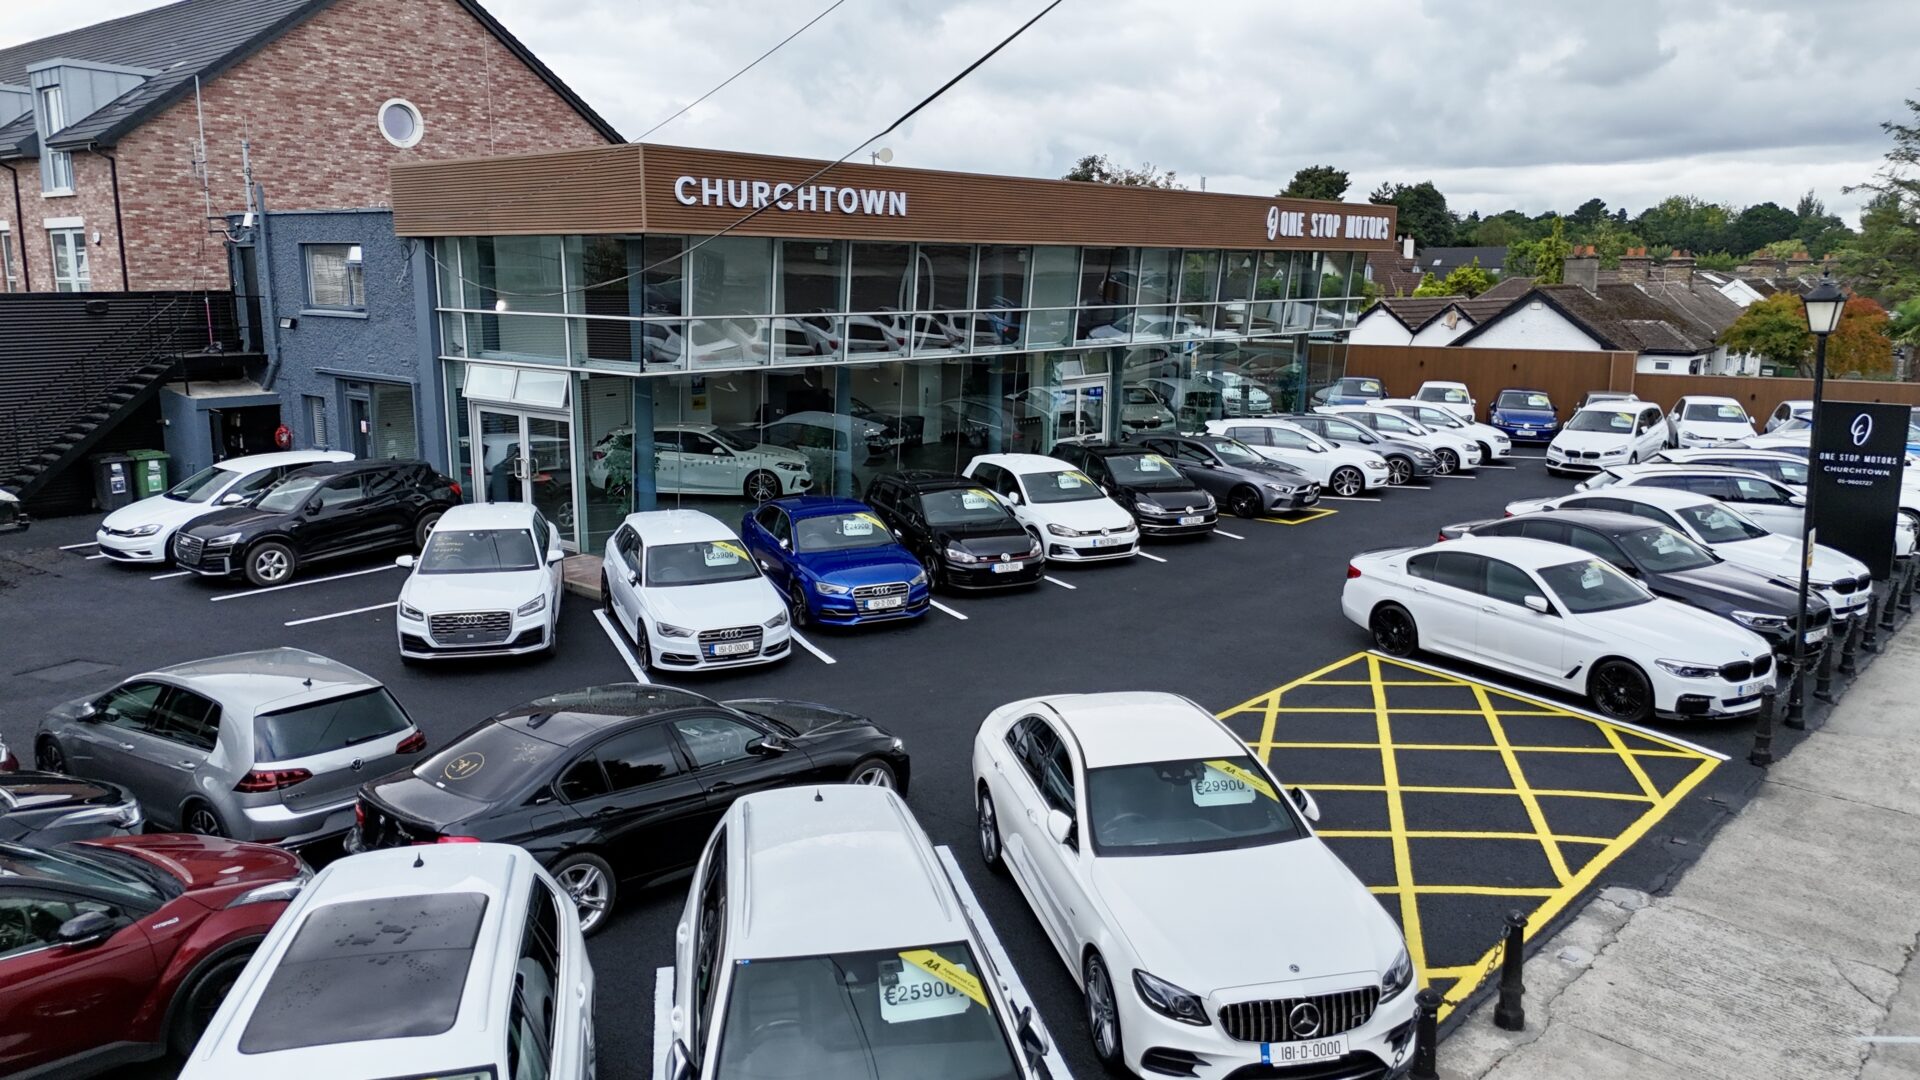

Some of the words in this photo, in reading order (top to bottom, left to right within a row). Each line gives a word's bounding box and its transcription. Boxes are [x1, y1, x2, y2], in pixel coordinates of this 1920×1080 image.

[674, 175, 907, 217] CHURCHTOWN
[1280, 211, 1305, 237] ONE
[1310, 213, 1341, 238] STOP
[1345, 215, 1390, 240] MOTORS
[1819, 452, 1836, 461] ONE
[1839, 453, 1860, 462] STOP
[1863, 455, 1897, 465] MOTORS
[1823, 465, 1890, 476] CHURCHTOWN
[718, 642, 750, 653] 151-D-0000
[1223, 766, 1236, 775] AA
[923, 959, 941, 971] AA
[1281, 1040, 1341, 1060] 181-D-0000
